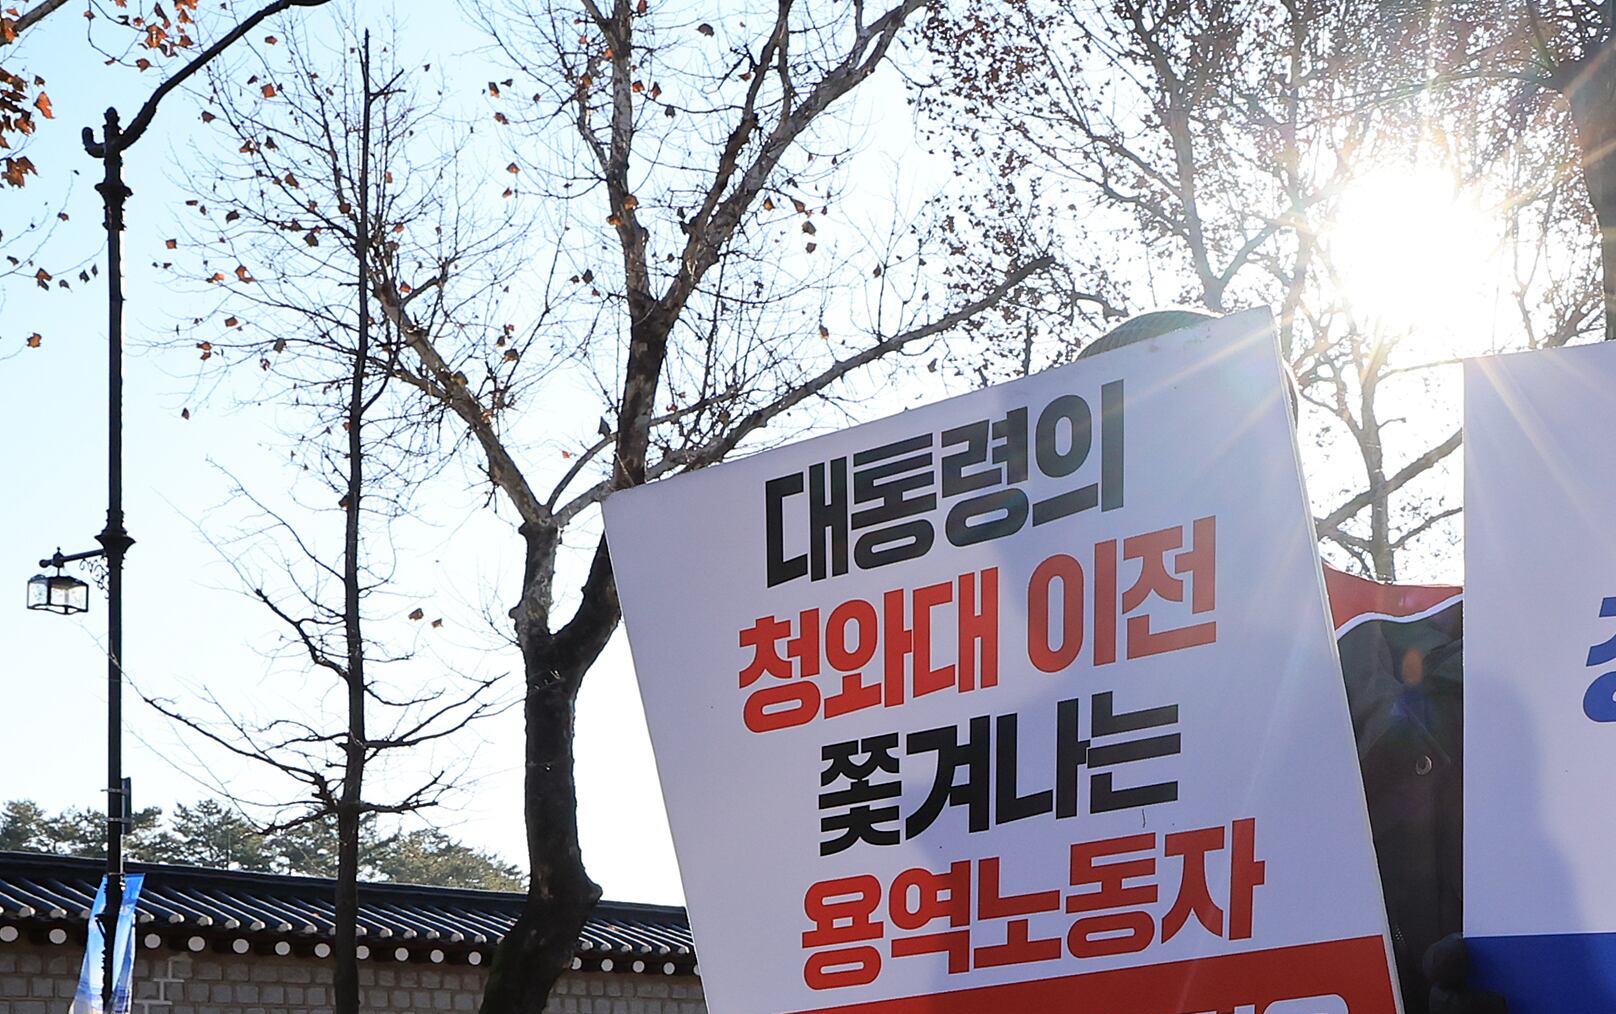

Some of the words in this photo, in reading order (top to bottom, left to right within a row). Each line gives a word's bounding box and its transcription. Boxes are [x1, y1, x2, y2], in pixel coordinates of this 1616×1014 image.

[766, 380, 1124, 587] 대통령의
[738, 567, 999, 733] 청와대
[1027, 516, 1217, 674] 이전
[819, 692, 1179, 856] 쫓겨나는
[802, 817, 1265, 990] 용역노동자
